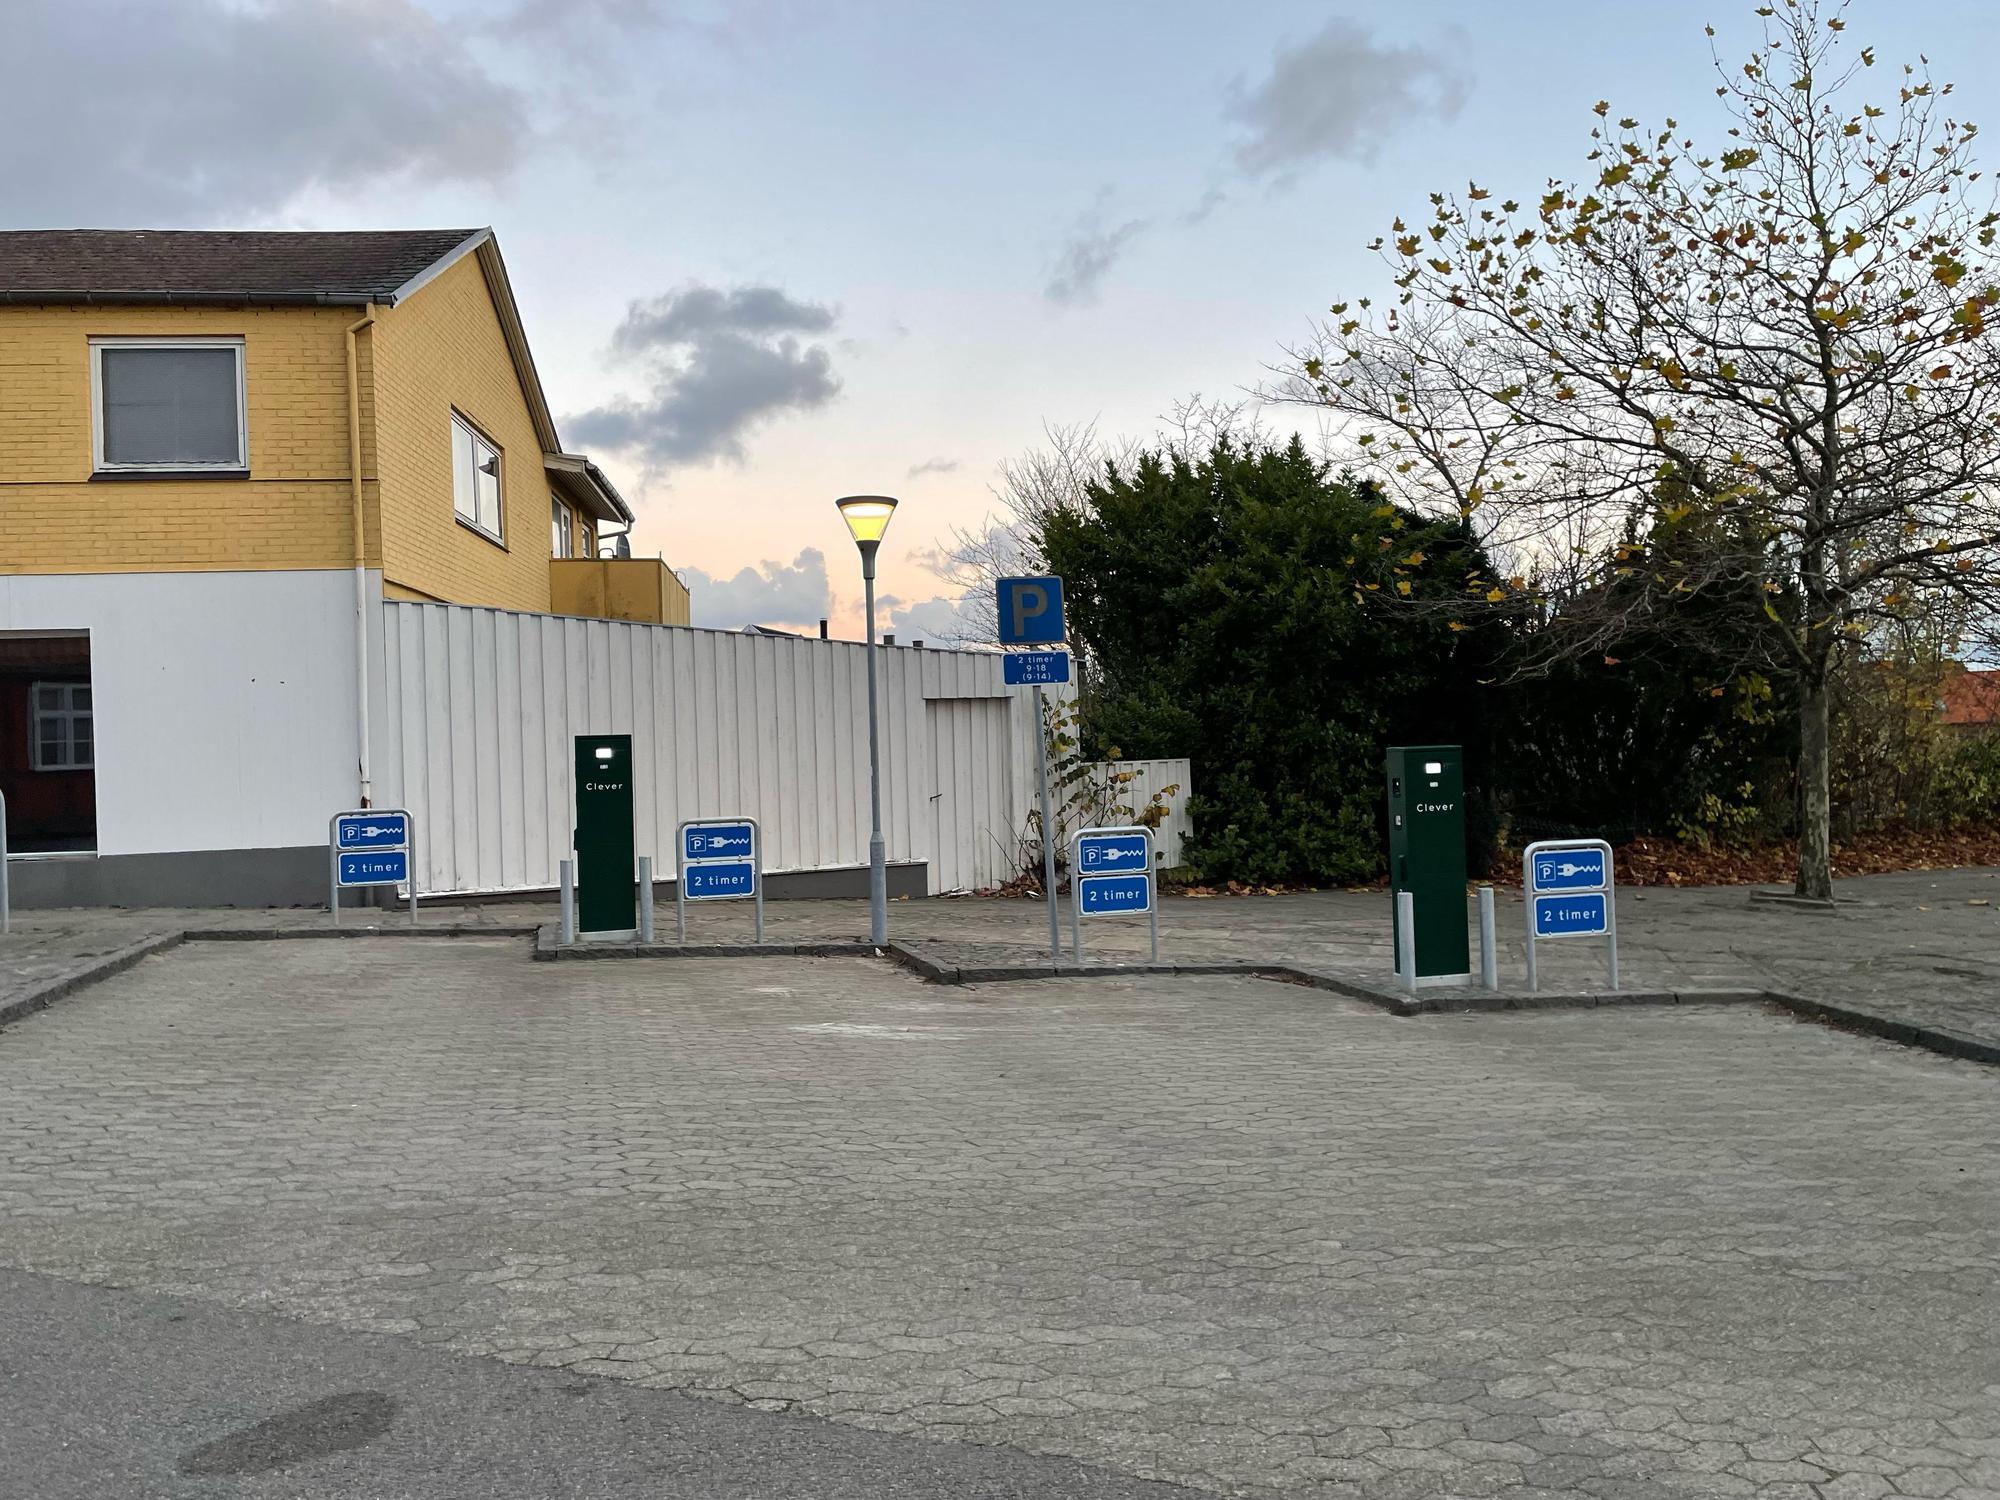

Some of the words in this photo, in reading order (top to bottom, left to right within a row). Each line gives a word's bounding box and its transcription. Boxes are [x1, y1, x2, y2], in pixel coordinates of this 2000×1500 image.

[1012, 584, 1048, 637] P
[1018, 656, 1024, 664] 2
[1416, 804, 1454, 812] Clever
[348, 830, 354, 838] P
[694, 840, 702, 850] P
[1088, 852, 1096, 862] P
[348, 864, 355, 873] 2
[362, 864, 398, 872] timer
[1543, 868, 1550, 878] P
[694, 876, 702, 886] 2
[709, 876, 744, 886] timer
[1090, 891, 1097, 901] 2
[1104, 890, 1140, 900] timer
[1544, 910, 1552, 922] 2
[1559, 910, 1596, 920] timer
